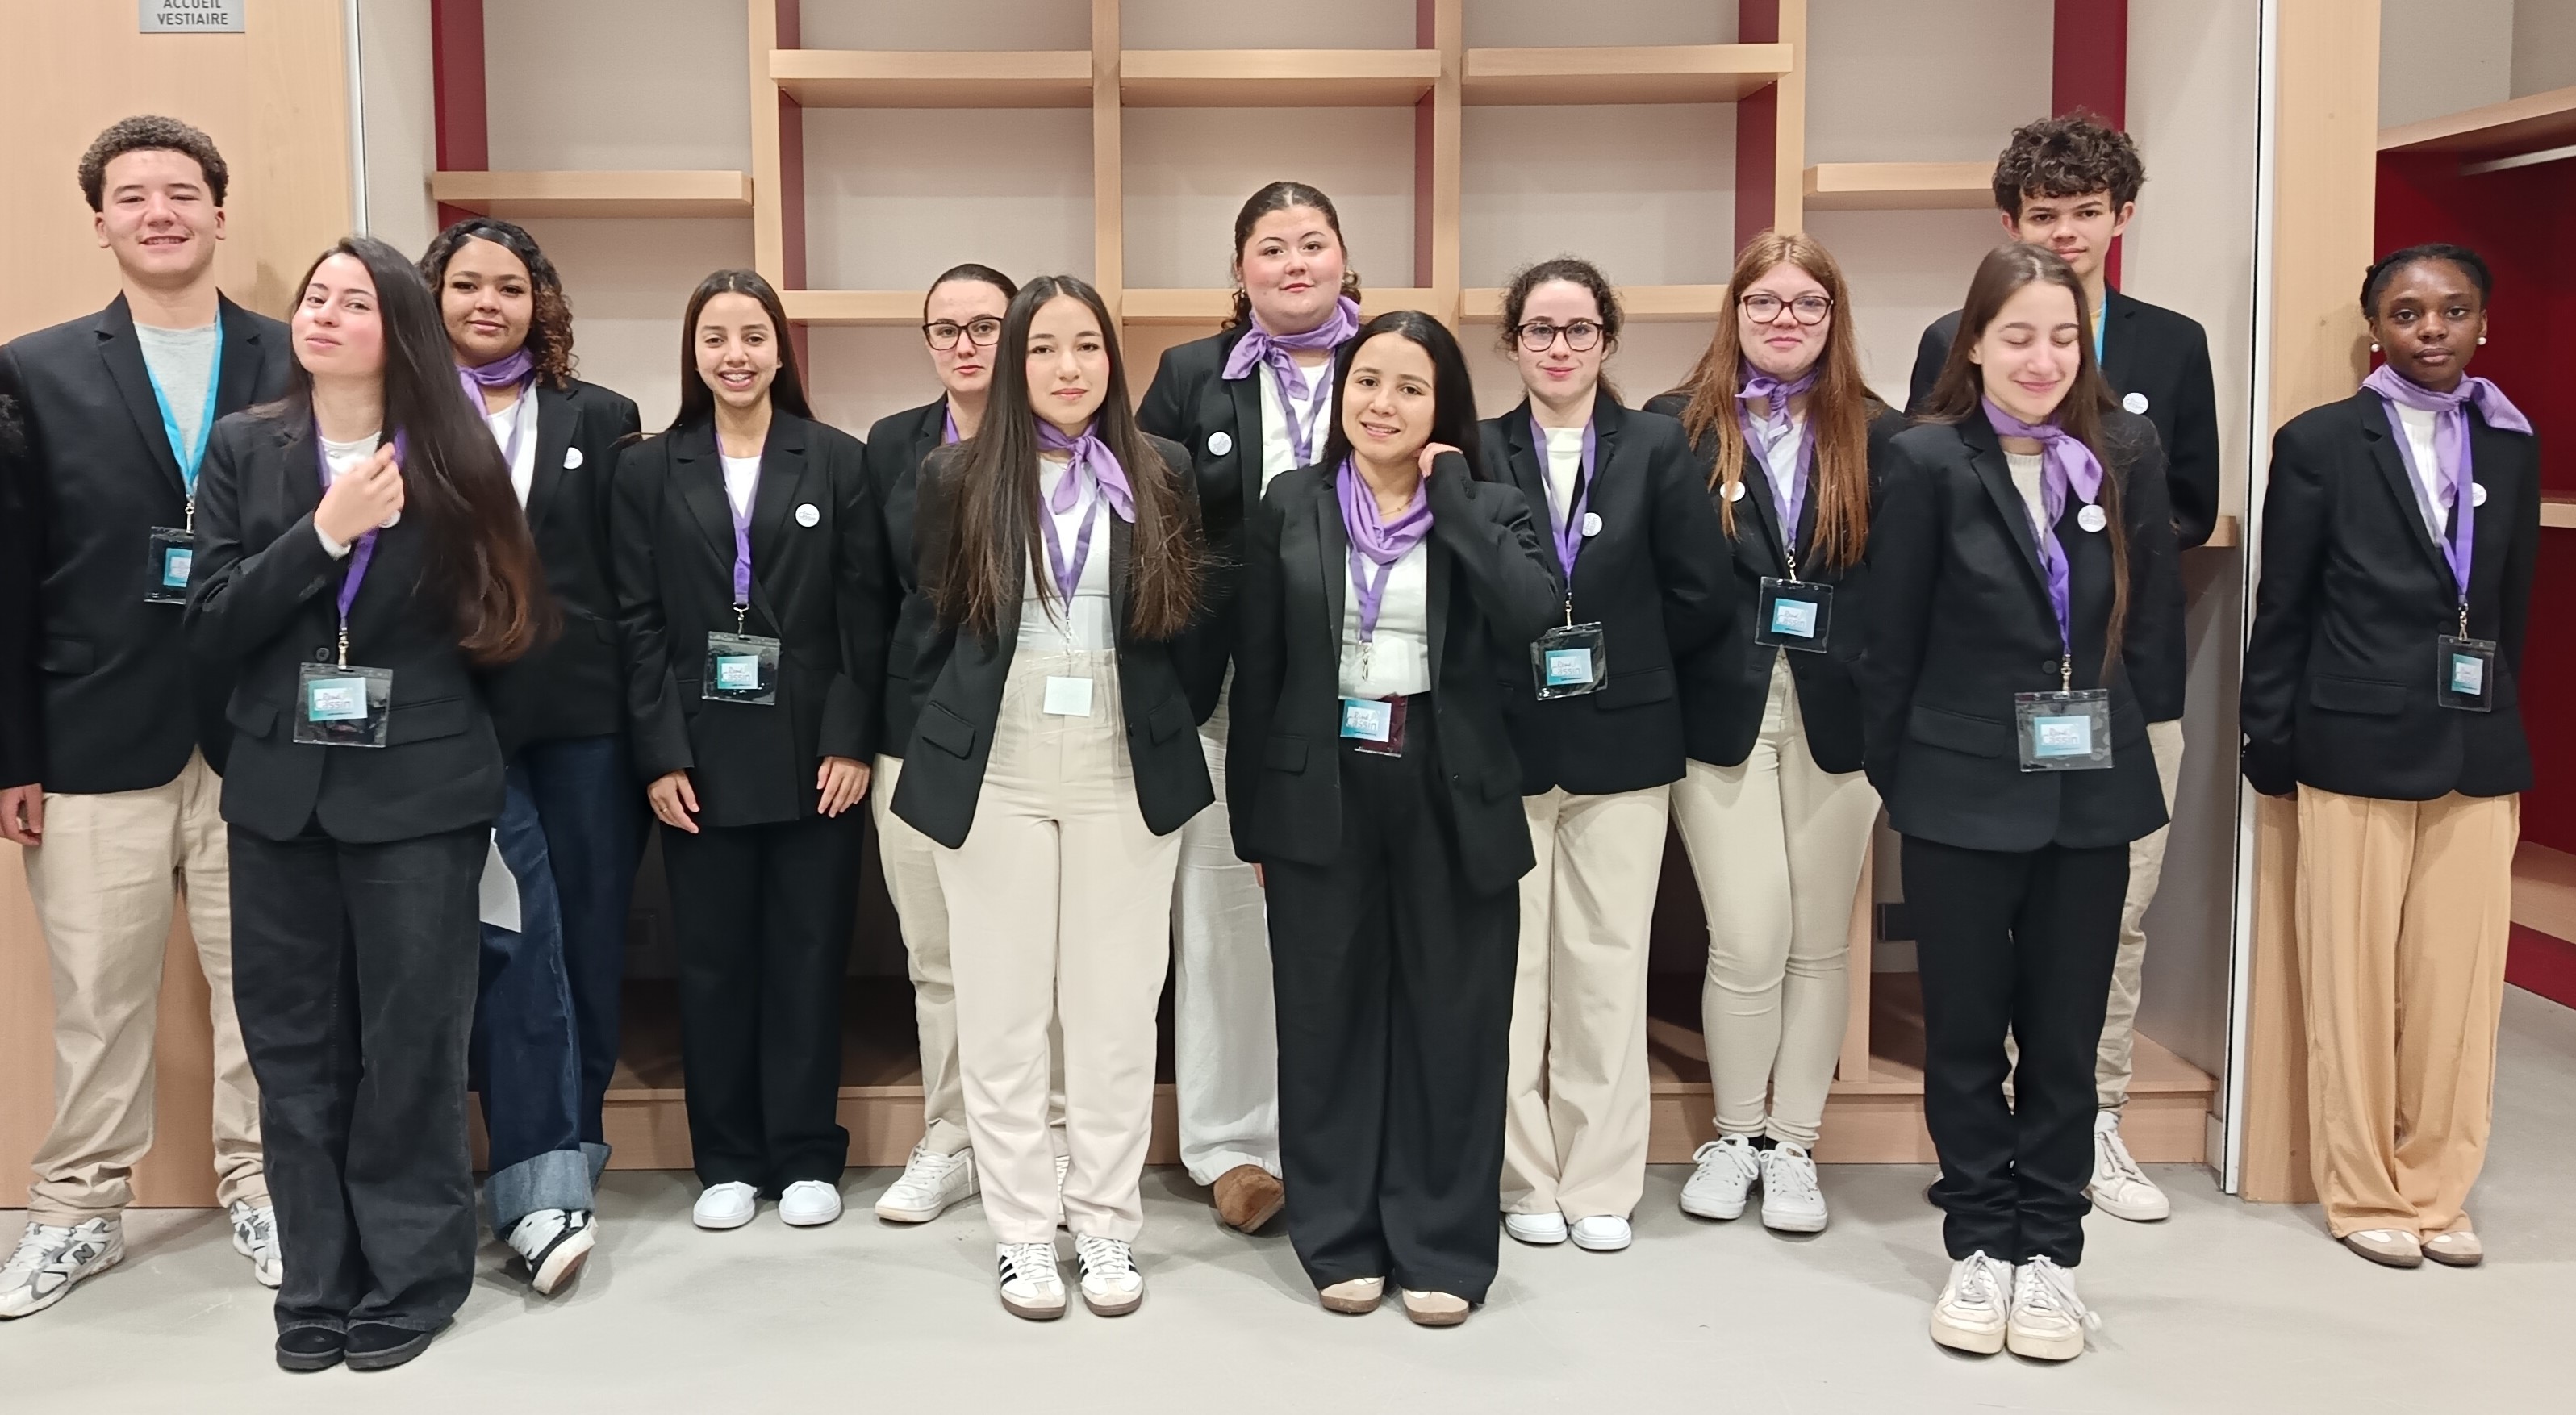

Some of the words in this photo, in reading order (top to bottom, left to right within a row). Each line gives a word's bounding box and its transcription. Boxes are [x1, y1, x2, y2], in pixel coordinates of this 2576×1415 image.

[163, 0, 222, 9] ACCUEIL
[157, 12, 228, 25] VESTIAIRE
[72, 1242, 96, 1266] N
